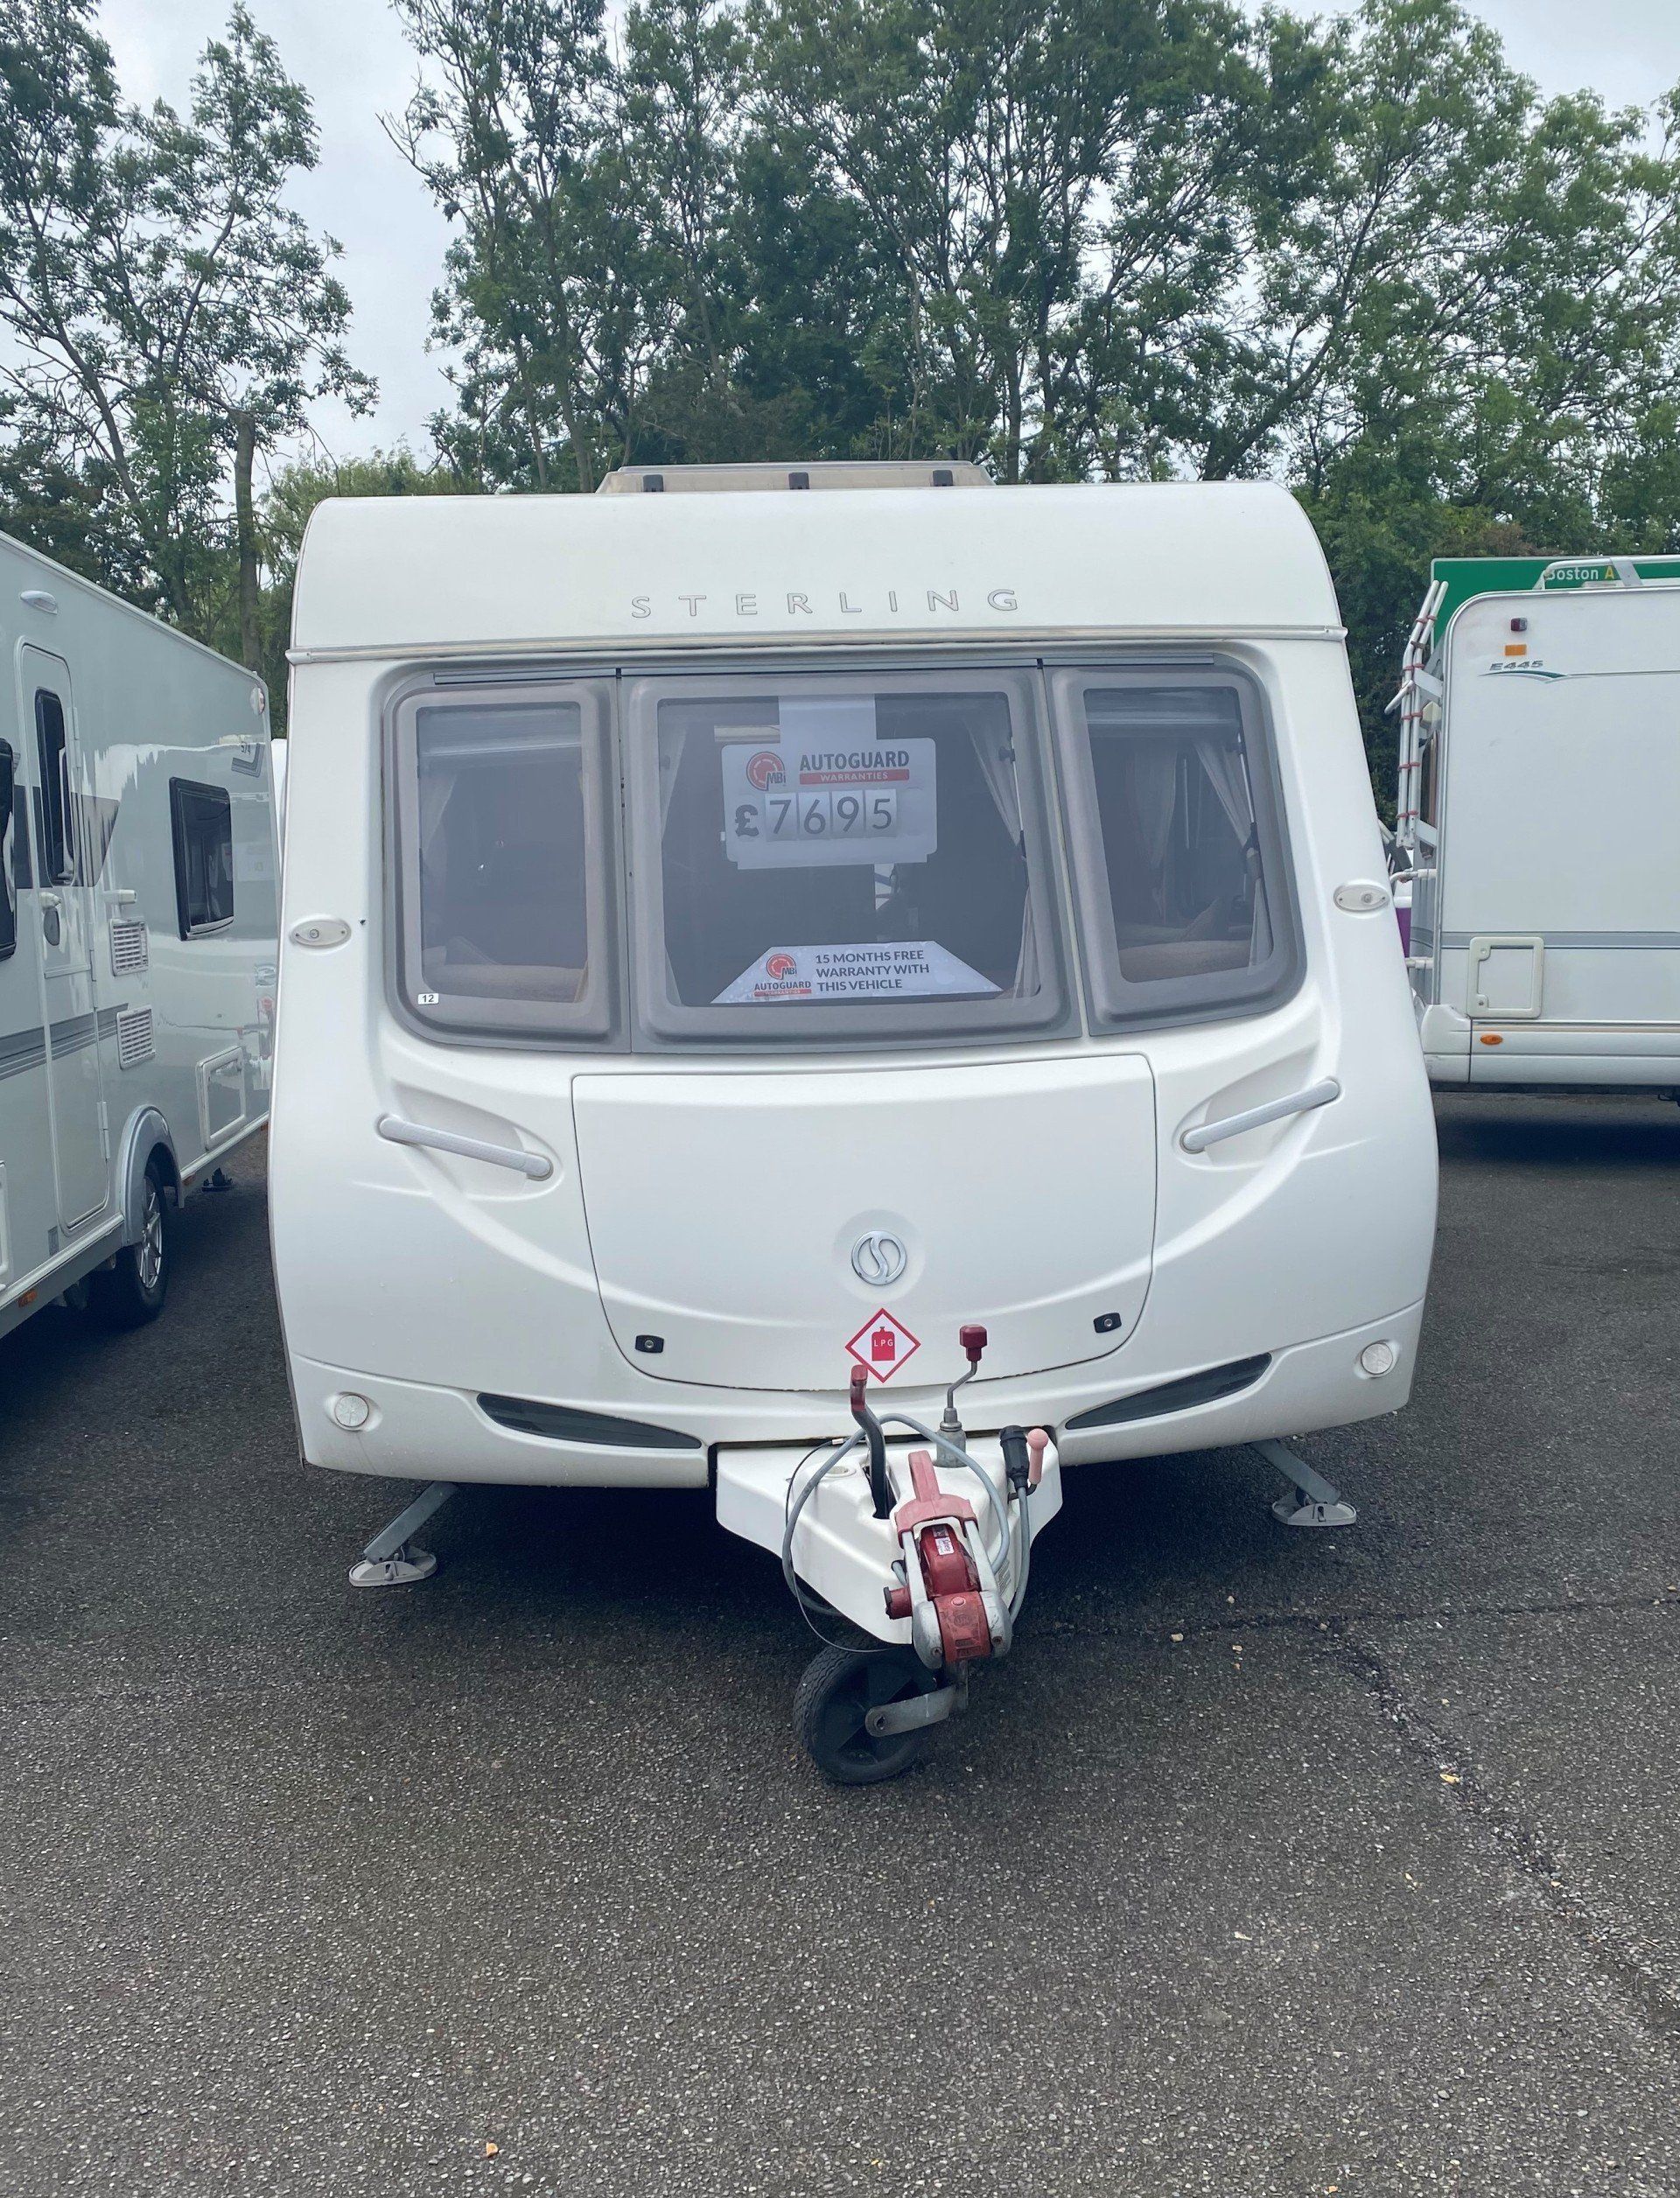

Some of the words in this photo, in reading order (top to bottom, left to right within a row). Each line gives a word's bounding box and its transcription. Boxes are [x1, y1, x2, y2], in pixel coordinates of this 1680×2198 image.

[1605, 565, 1614, 579] A
[631, 588, 1018, 618] STERLING
[1489, 661, 1544, 671] E445
[800, 751, 909, 771] AUTOGUARD
[820, 771, 888, 781] WARRANTIES
[816, 954, 830, 963] 15
[833, 952, 891, 962] MONTHS
[894, 950, 924, 960] FREE
[816, 965, 891, 977] WARRANTY
[893, 964, 929, 975] WITH
[754, 981, 811, 990] AUTOGUARD
[817, 981, 846, 991] THIS
[849, 979, 902, 990] VEHICLE
[423, 994, 435, 1003] 12
